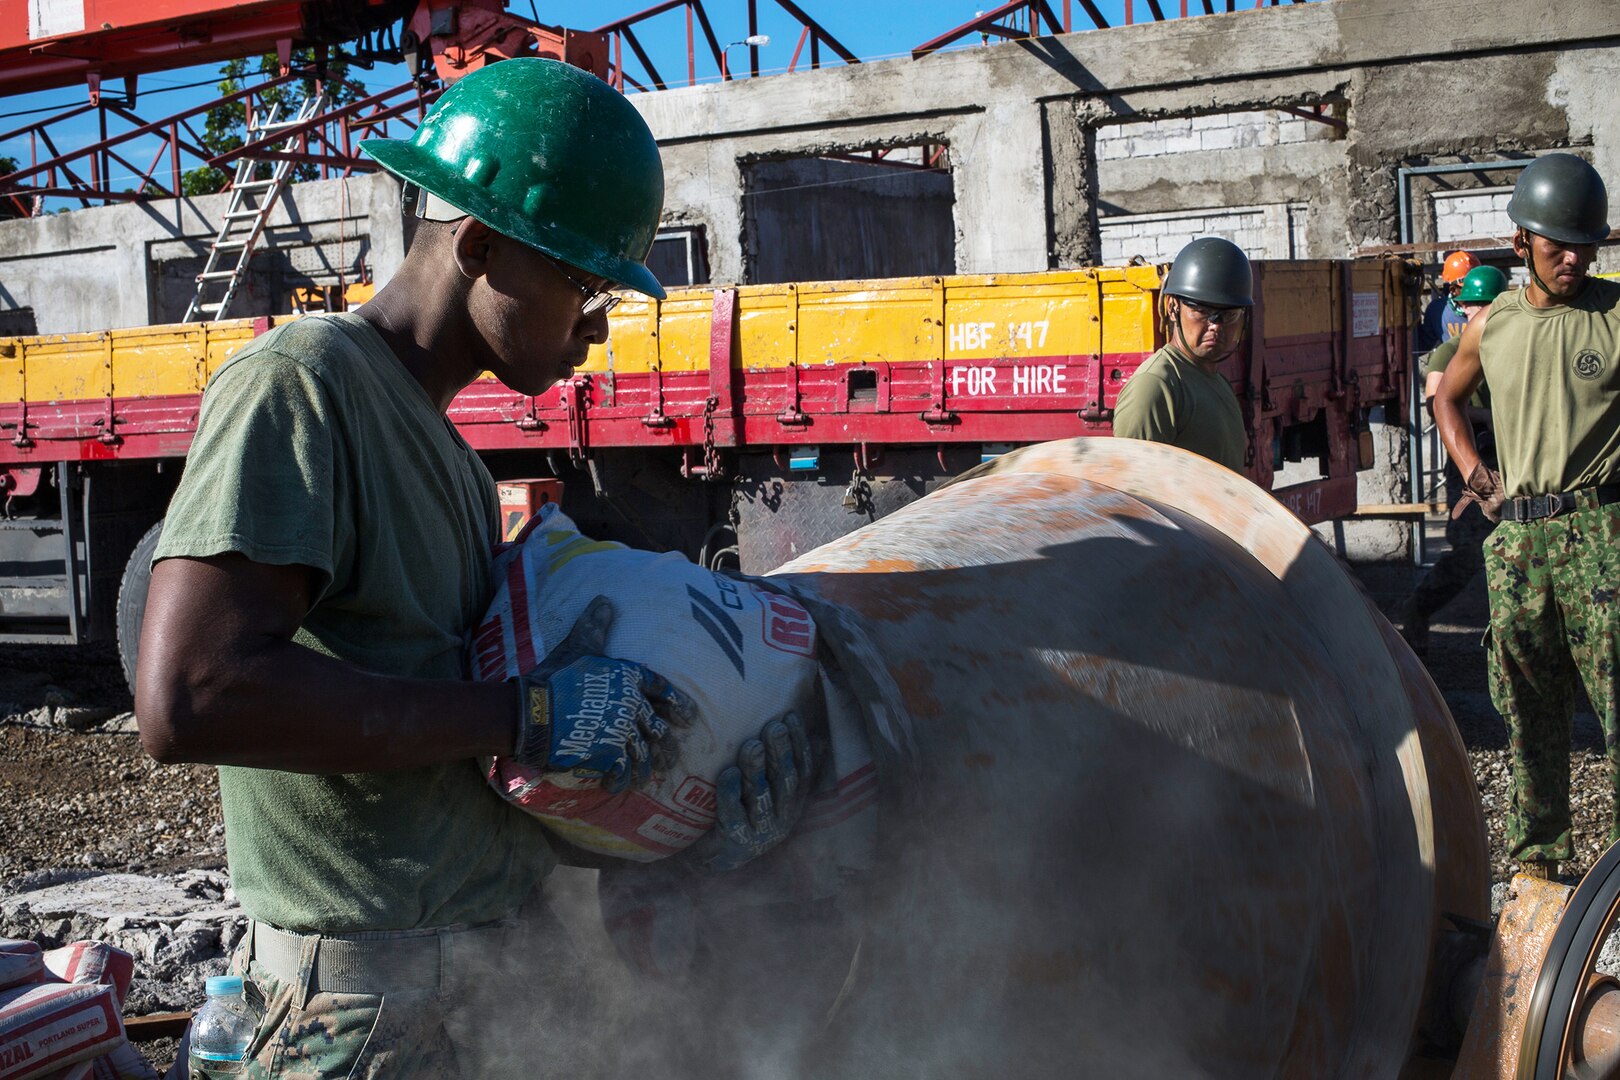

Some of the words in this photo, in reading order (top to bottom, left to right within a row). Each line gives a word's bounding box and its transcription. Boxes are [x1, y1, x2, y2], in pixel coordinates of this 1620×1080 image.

[949, 322, 996, 351] HBF
[1008, 320, 1049, 349] 147
[952, 365, 997, 396] FOR
[1013, 364, 1067, 395] HIRE
[555, 672, 611, 759] Mechanix
[682, 784, 717, 812] RIZ
[38, 1027, 75, 1048] PORTLAND
[76, 1017, 101, 1032] SUPER
